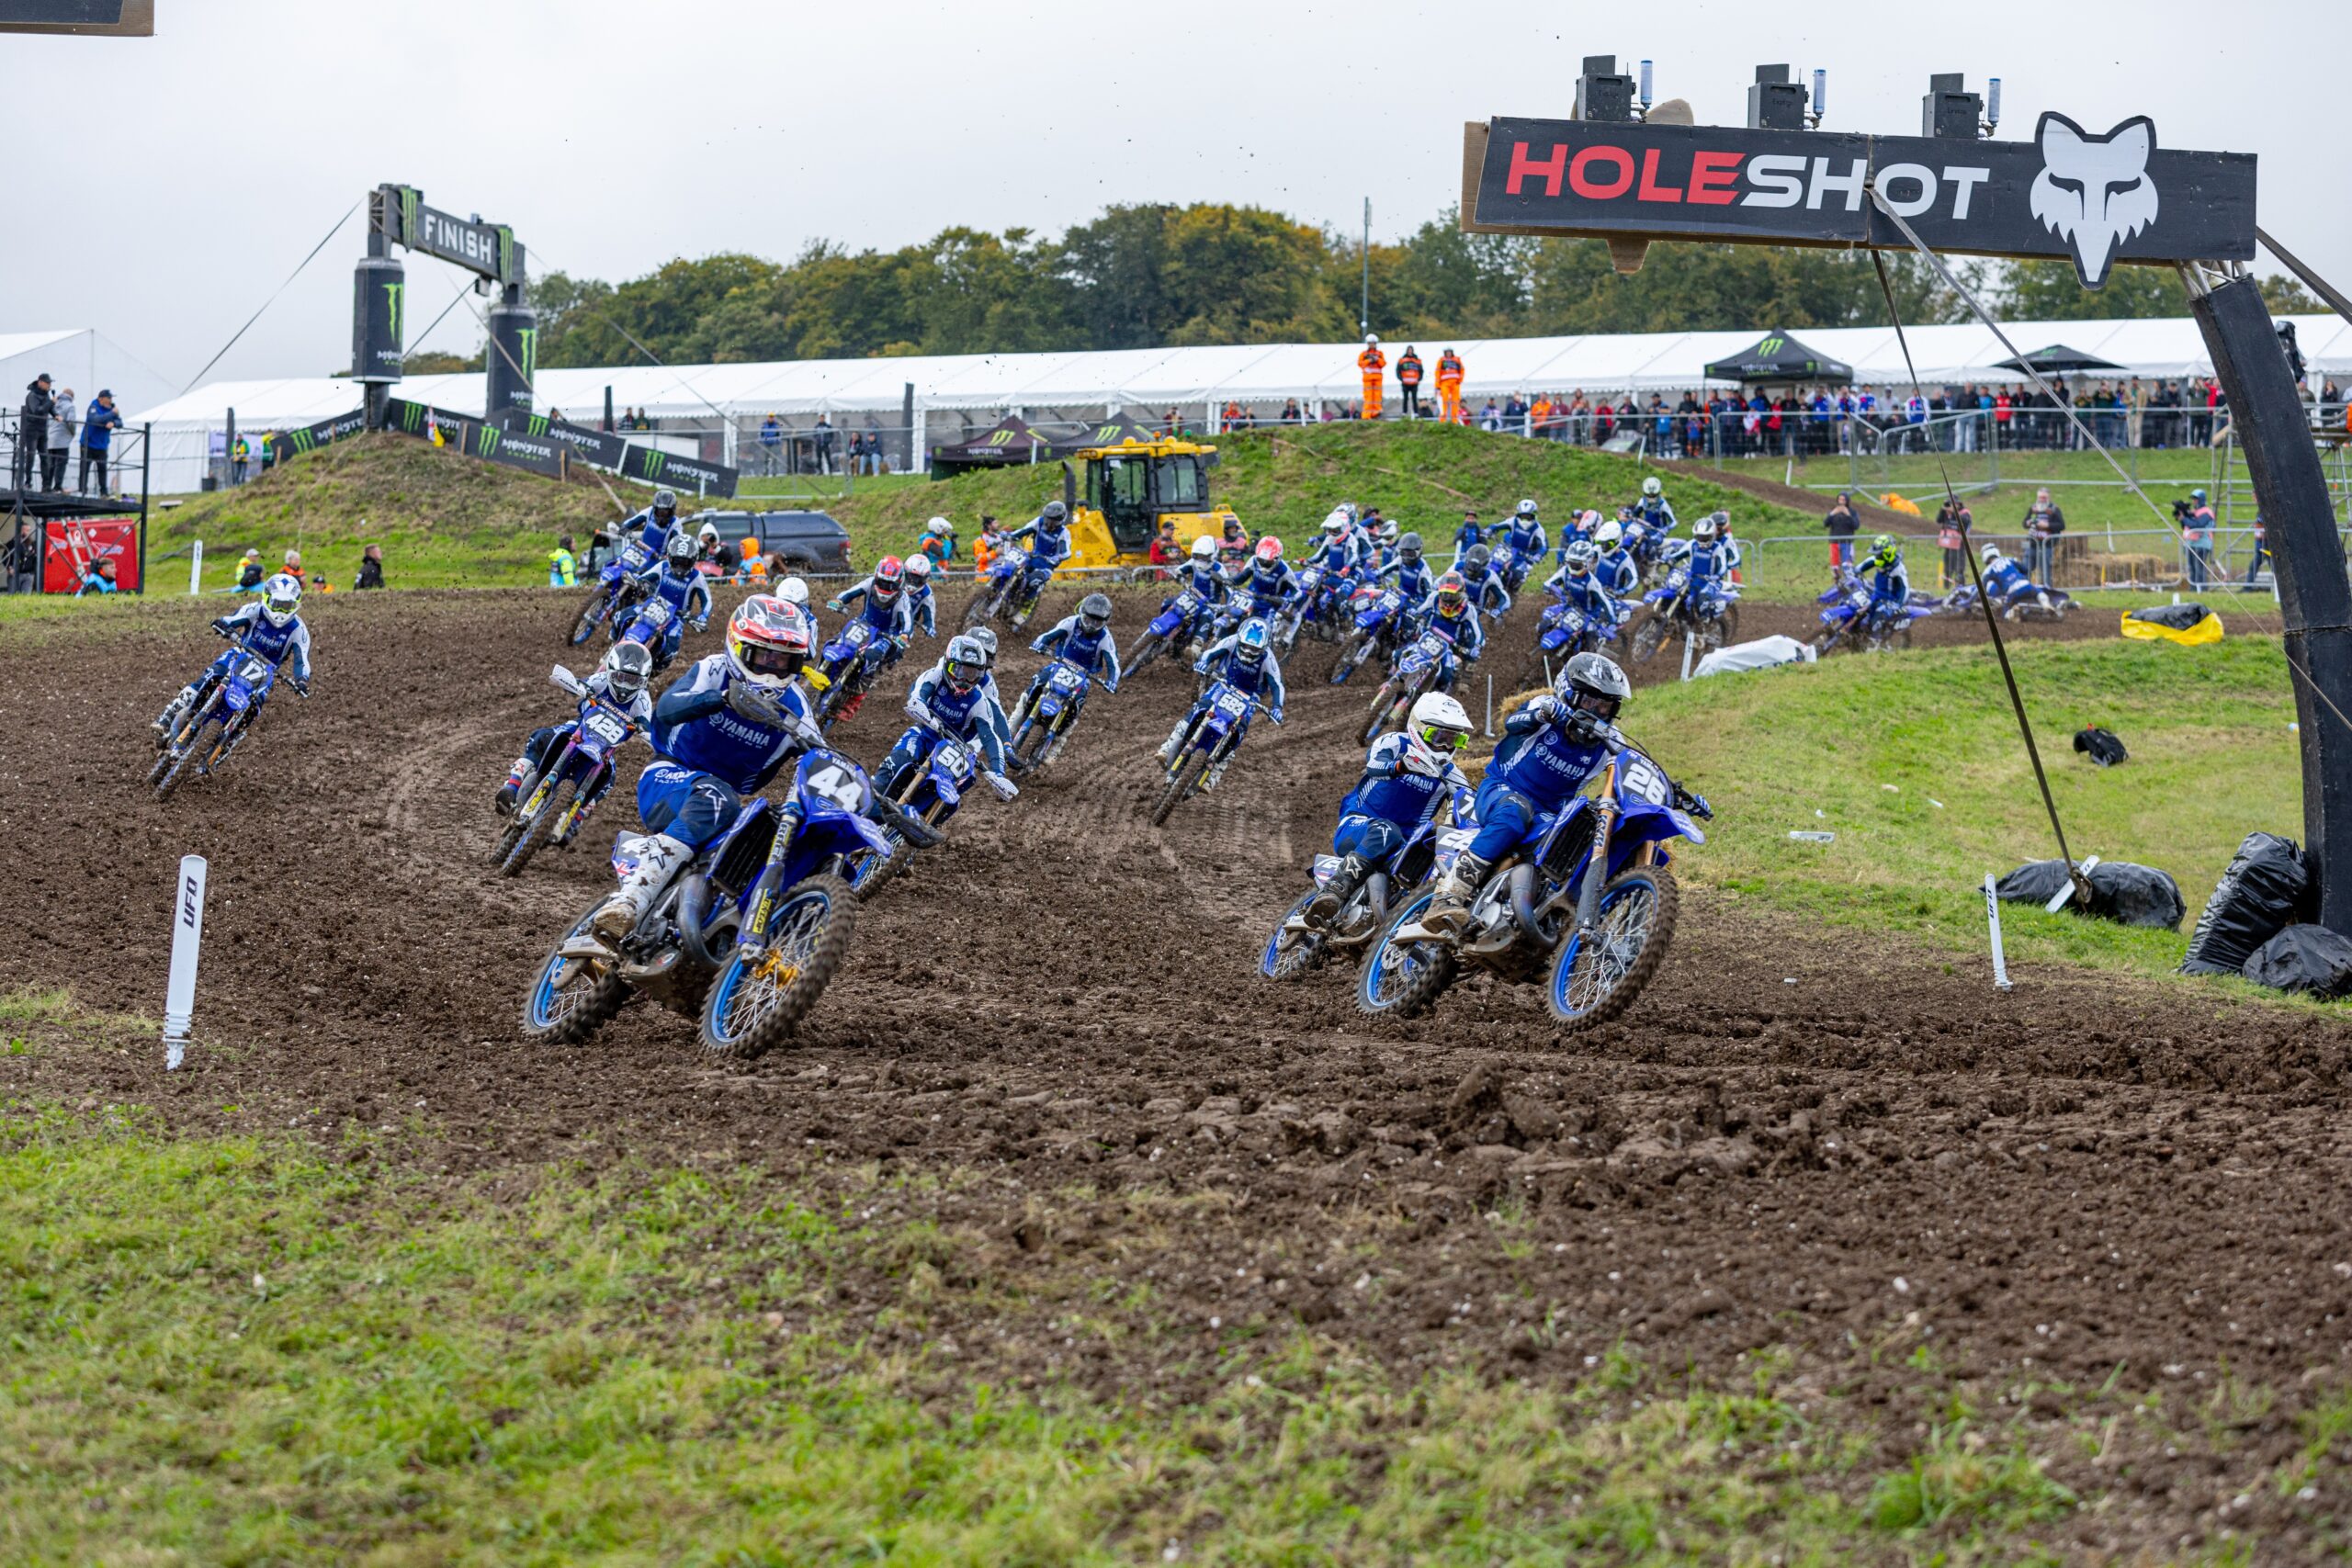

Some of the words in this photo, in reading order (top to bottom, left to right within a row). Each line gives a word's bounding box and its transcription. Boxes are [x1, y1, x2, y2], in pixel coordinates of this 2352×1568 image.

[1504, 141, 1990, 220] HOLESHOT
[424, 213, 492, 265] FINISH
[501, 437, 552, 458] MONSTER
[665, 460, 719, 483] MONSTER
[258, 632, 284, 649] YAMAHA
[938, 701, 964, 719] YAMAHA
[585, 713, 626, 745] 428
[721, 716, 771, 747] YAMAHA
[936, 745, 970, 778] 50
[1544, 750, 1587, 778] YAMAHA
[806, 764, 864, 813] 44
[1402, 773, 1434, 792] YAMAHA
[1622, 762, 1667, 806] 26
[1458, 794, 1478, 821] 7
[183, 874, 198, 930] UFO
[1986, 888, 1995, 919] UFO
